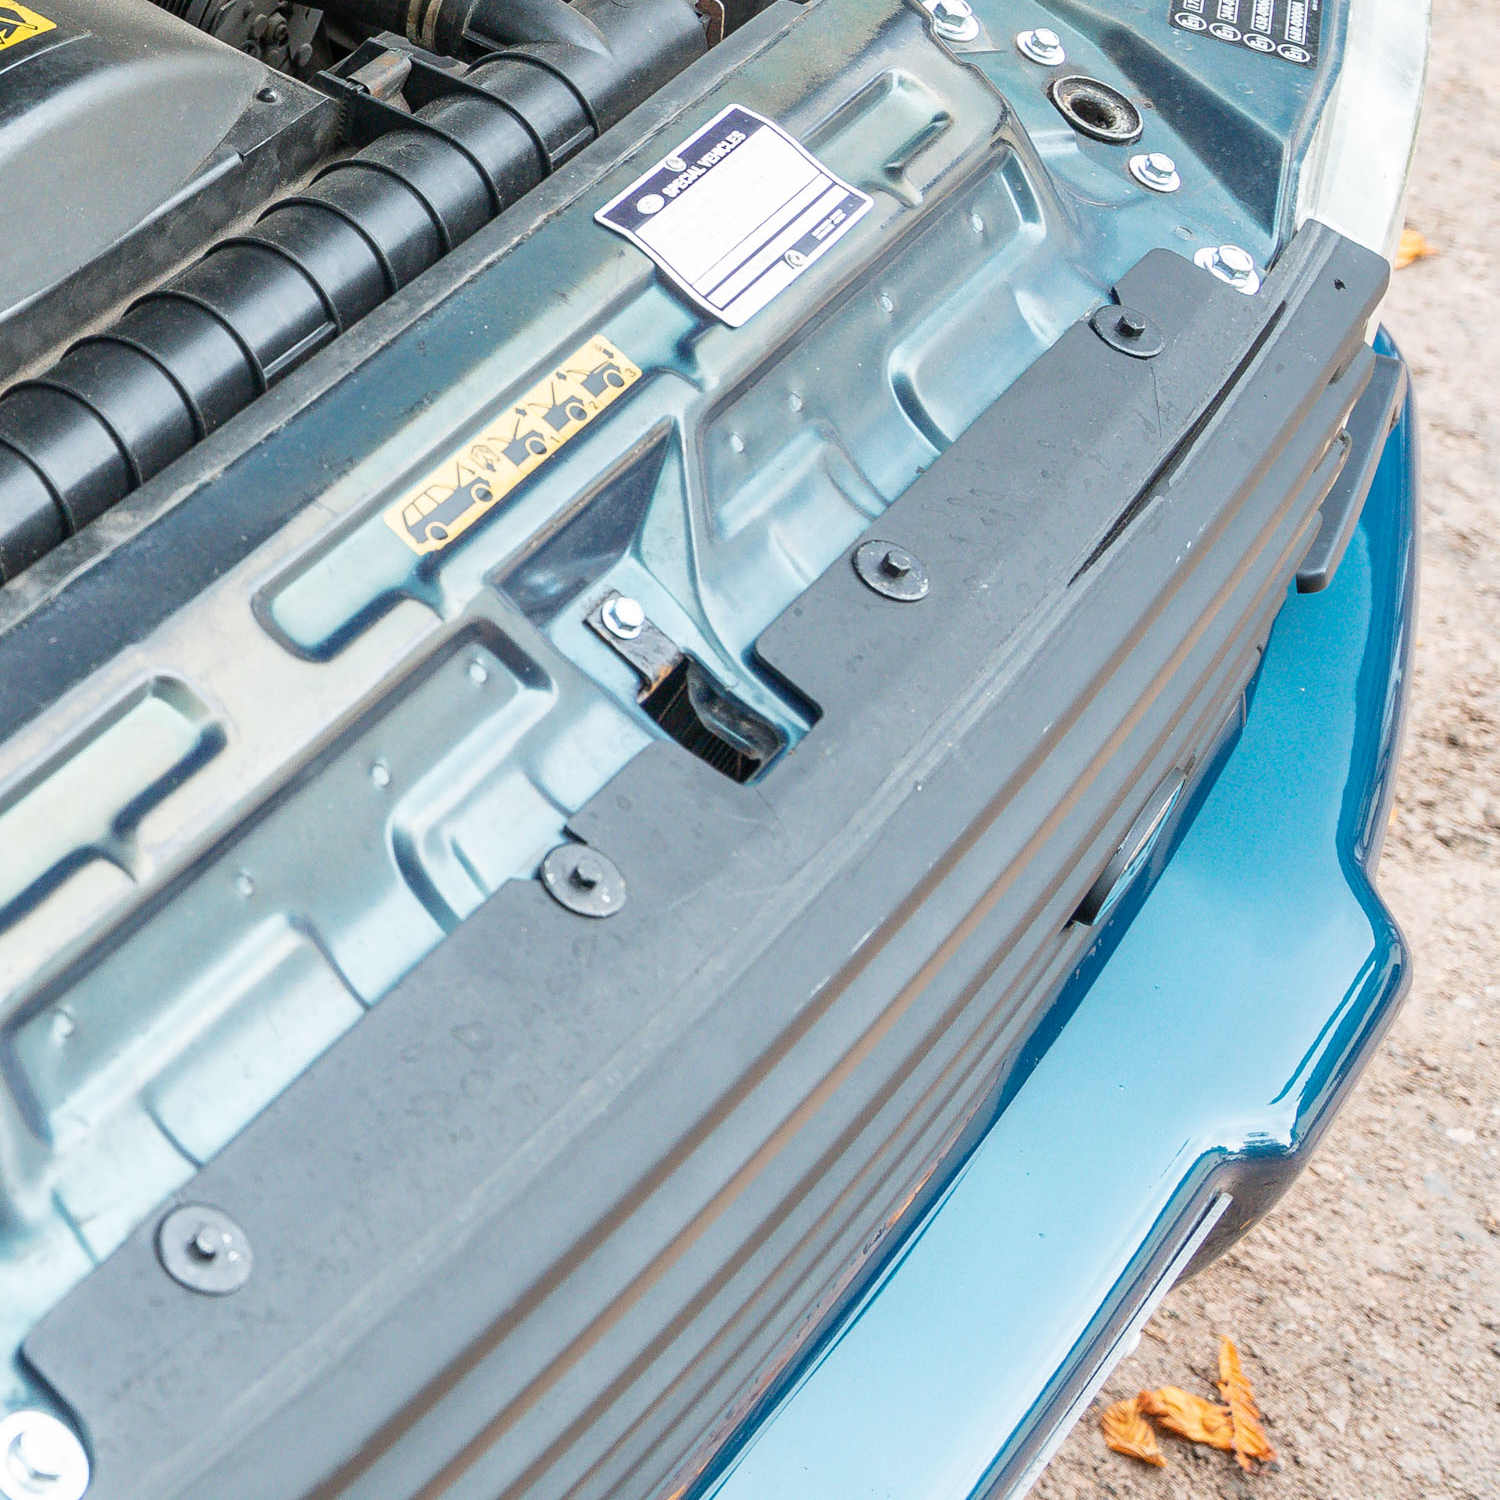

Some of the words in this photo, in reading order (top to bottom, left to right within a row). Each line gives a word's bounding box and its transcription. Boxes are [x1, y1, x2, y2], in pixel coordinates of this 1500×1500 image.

[661, 165, 707, 198] SPECIAL
[696, 130, 747, 168] VEHICLES
[624, 367, 637, 378] 3
[587, 400, 599, 410] 2
